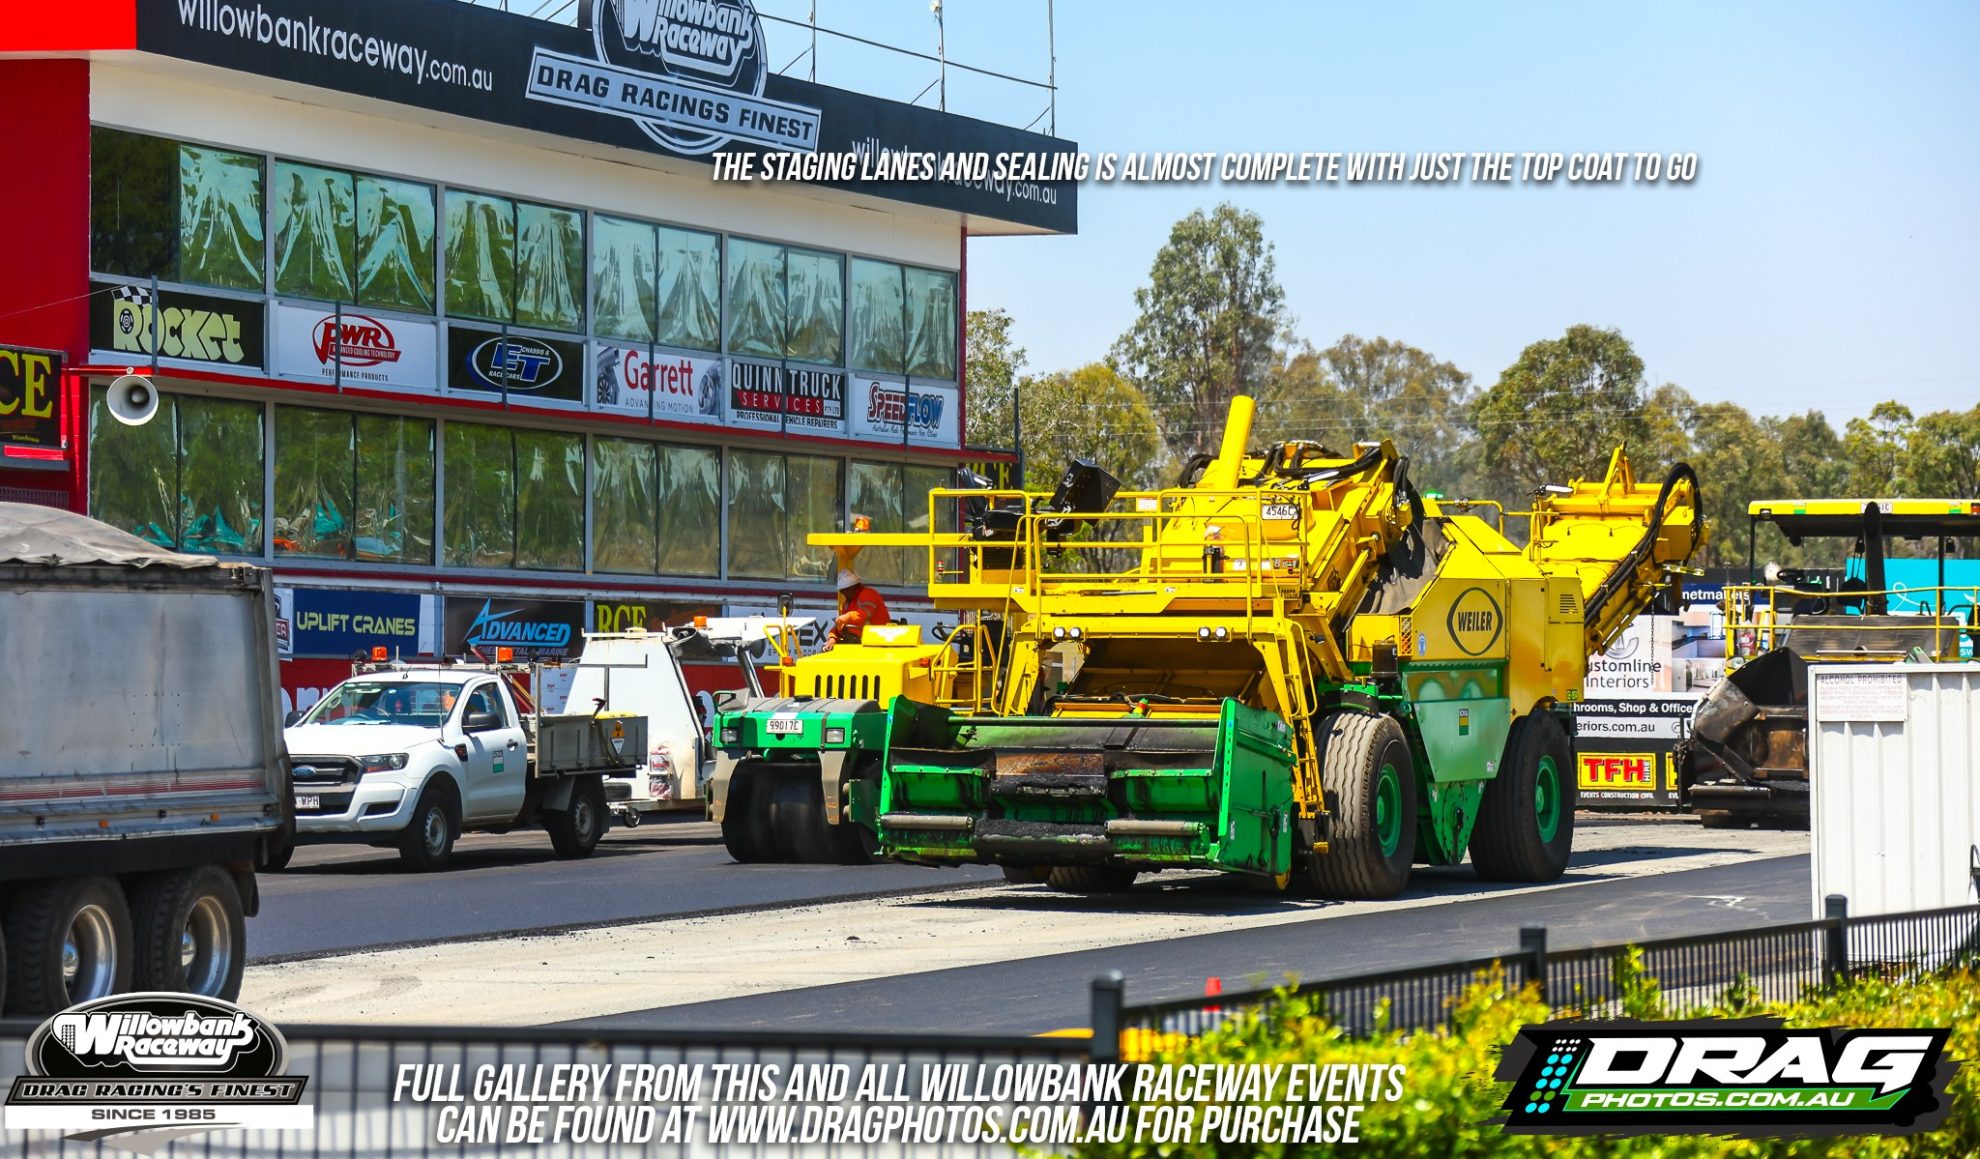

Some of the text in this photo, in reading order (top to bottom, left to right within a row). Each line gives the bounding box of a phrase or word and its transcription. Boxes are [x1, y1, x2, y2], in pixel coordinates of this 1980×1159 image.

[178, 0, 492, 91] willowbankraceway.com.au
[537, 65, 814, 141] DRAG RACINGS FINEST
[624, 349, 694, 396] Garrett
[732, 363, 841, 399] QUINN TRUCK
[625, 398, 694, 413] ADVANNG MOTION
[742, 392, 821, 414] SERVICES
[736, 411, 780, 422] PROFESSIONAL
[807, 417, 838, 429] REPAIRERS
[297, 611, 416, 637] UPLIFT CRANES
[463, 597, 571, 646] ADVANCED
[1458, 611, 1492, 632] WEILER
[1858, 674, 1902, 684] PROHIBITED
[1619, 702, 1646, 713] Shop
[1649, 703, 1658, 713] &
[1661, 702, 1693, 713] Office
[770, 720, 799, 731] 99017C
[1584, 758, 1645, 782] TFH
